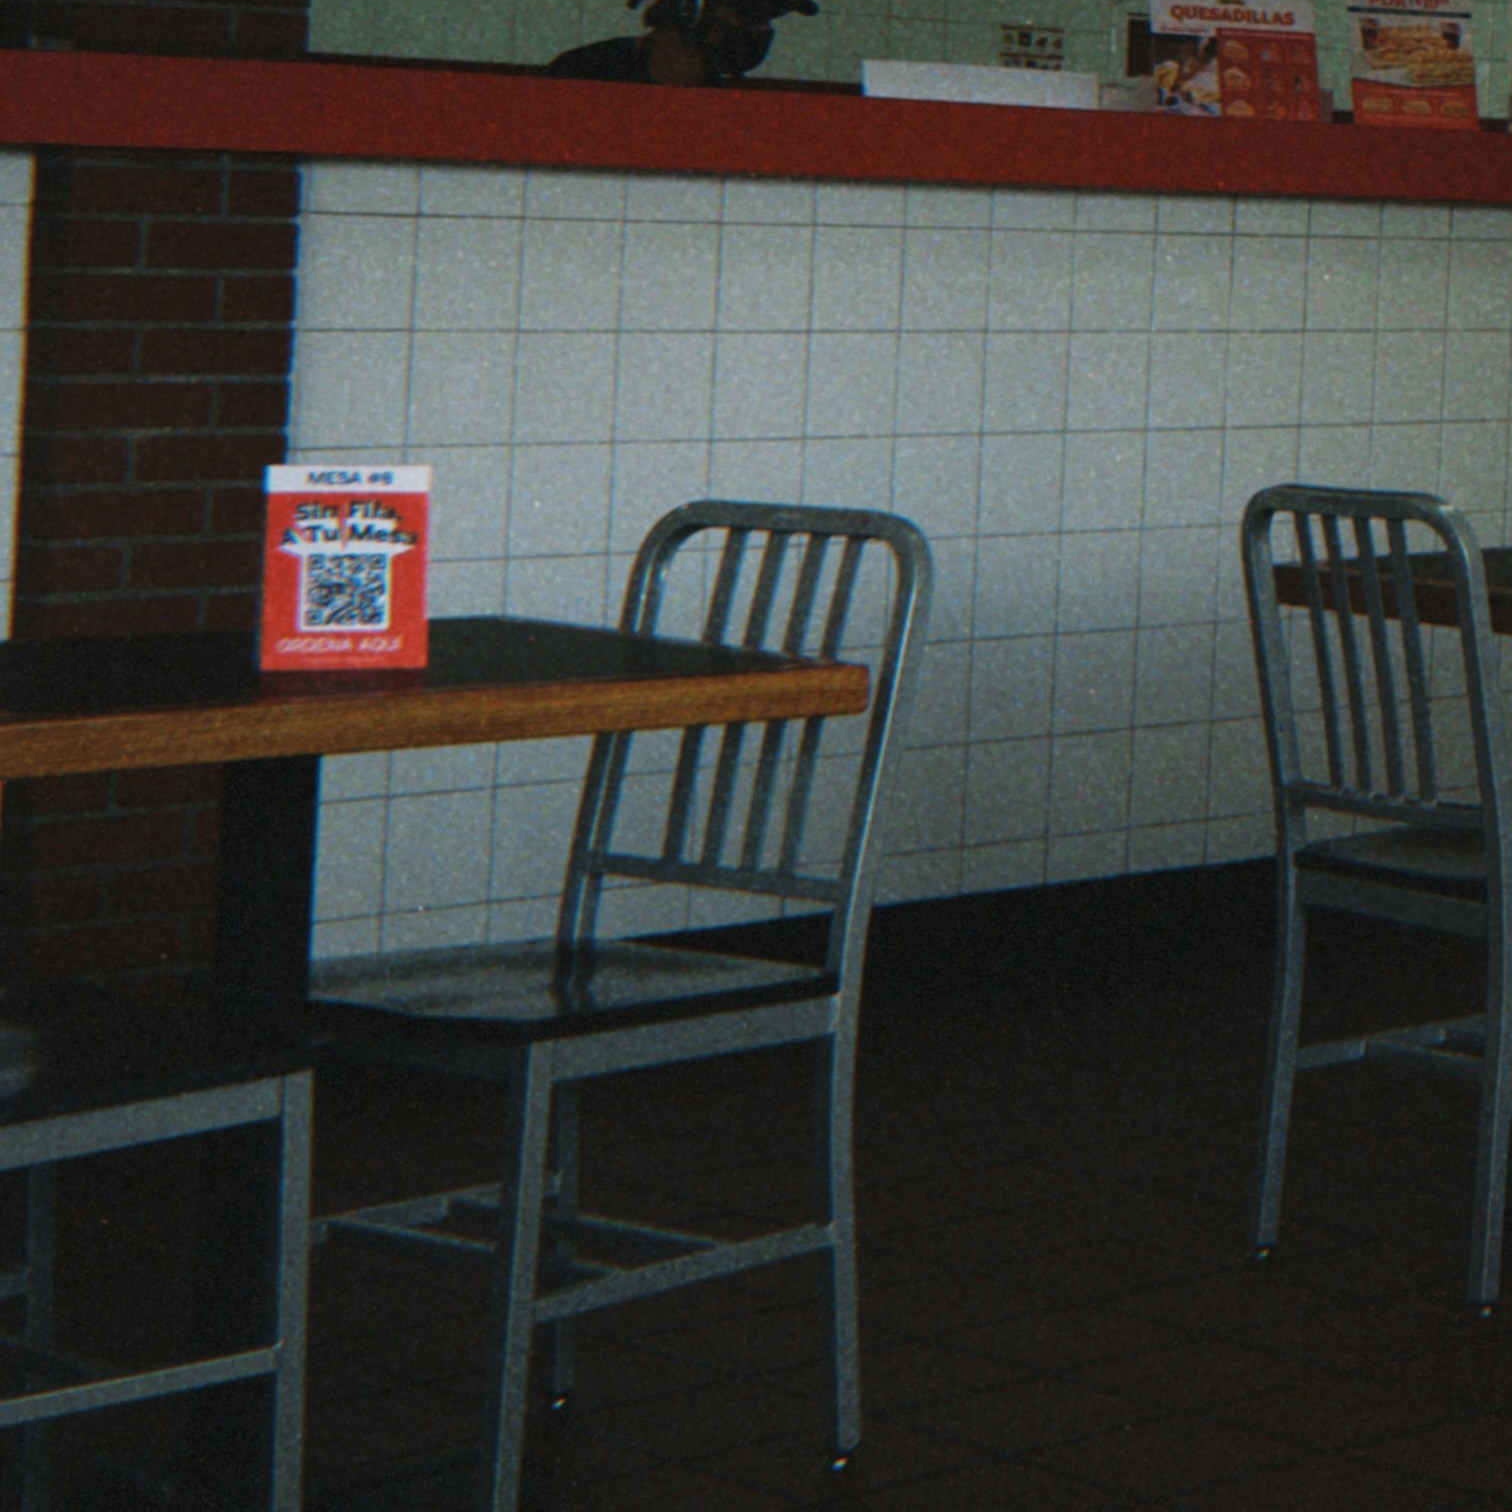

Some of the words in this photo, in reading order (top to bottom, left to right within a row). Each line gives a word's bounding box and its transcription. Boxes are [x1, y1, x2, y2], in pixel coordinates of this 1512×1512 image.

[1169, 4, 1295, 26] QUESADILLAS
[306, 471, 361, 485] MESA
[295, 502, 338, 520] Sin
[281, 528, 299, 545] A
[304, 525, 340, 542] Tu
[348, 524, 418, 545] Mesa
[275, 637, 353, 654] ORDENA
